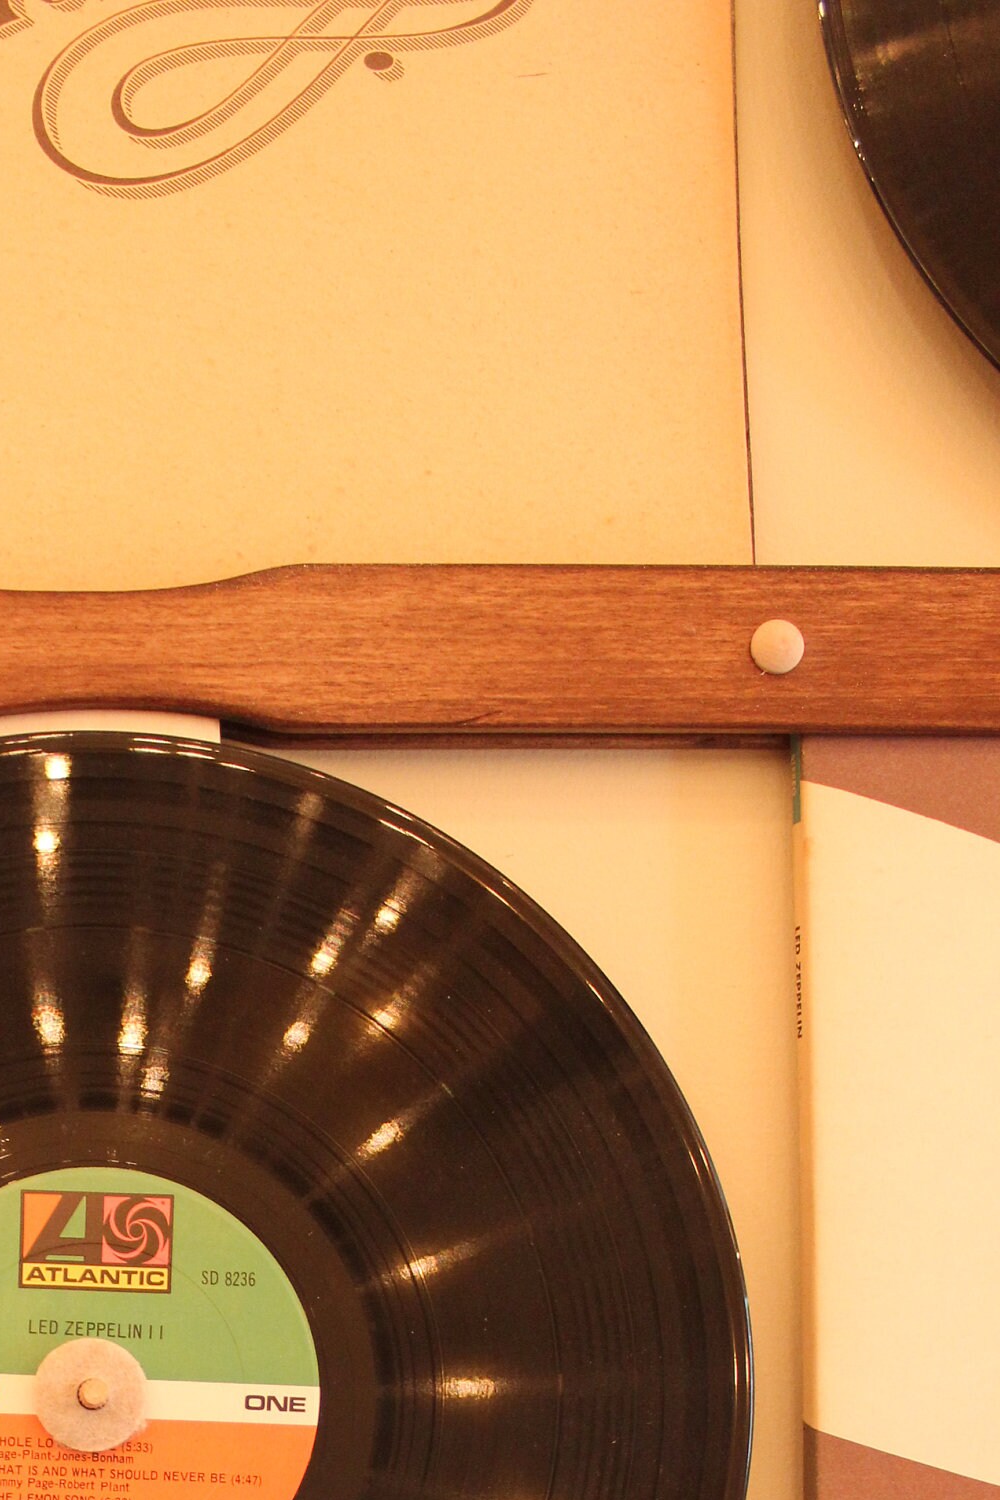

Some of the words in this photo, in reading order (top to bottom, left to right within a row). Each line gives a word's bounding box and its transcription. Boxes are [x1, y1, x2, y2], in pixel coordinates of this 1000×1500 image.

[26, 1266, 165, 1286] ATLANTIC
[201, 1271, 219, 1286] SD
[225, 1272, 256, 1287] 8236
[28, 1319, 58, 1335] LED
[65, 1320, 142, 1339] ZEPPELIN
[244, 1394, 307, 1413] ONE
[121, 1441, 153, 1454] (5:33)
[27, 1477, 95, 1491] Page-Robert
[101, 1481, 130, 1492] Plant
[28, 1465, 38, 1476] IS
[42, 1466, 67, 1477] AND
[72, 1467, 105, 1478] WHAT
[110, 1469, 158, 1480] SHOULD
[163, 1471, 205, 1482] NEVER
[210, 1472, 226, 1483] BE
[231, 1474, 262, 1488] (4:47)
